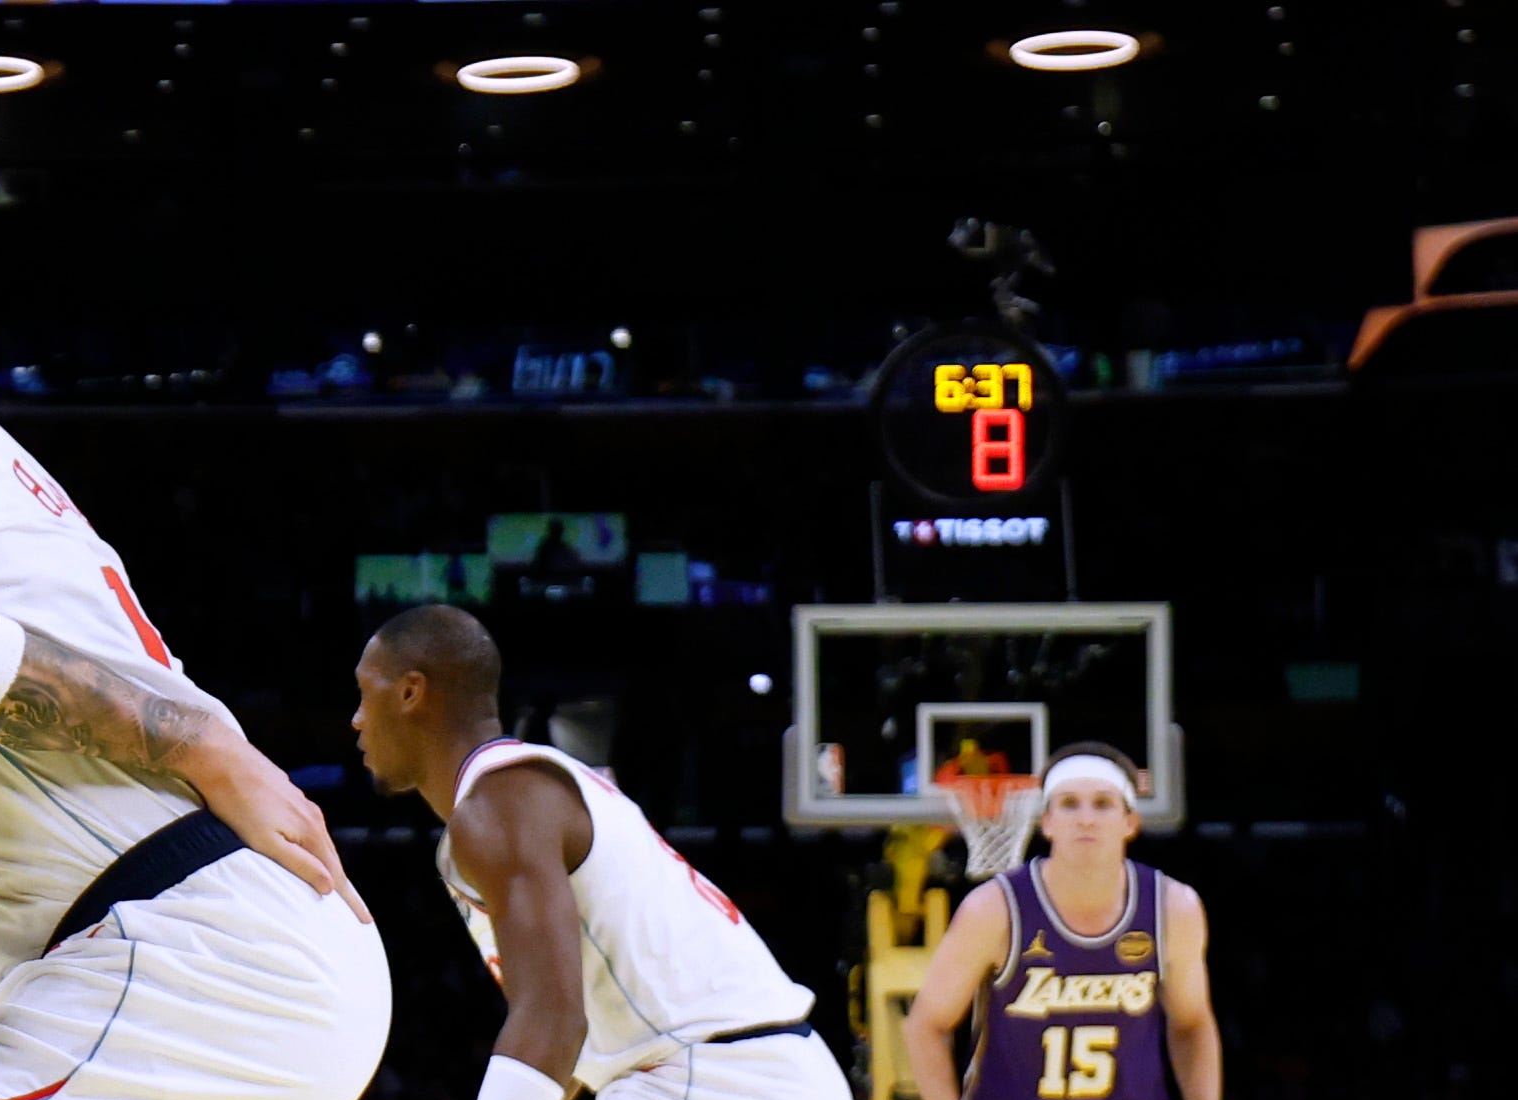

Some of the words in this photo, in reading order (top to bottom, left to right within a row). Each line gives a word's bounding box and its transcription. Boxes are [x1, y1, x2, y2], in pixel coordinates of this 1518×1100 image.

[934, 363, 1033, 413] 6:37
[971, 408, 1026, 491] 8
[933, 517, 1049, 547] TISSOT
[1004, 966, 1157, 1018] LAKERS
[1037, 1025, 1120, 1100] 15
